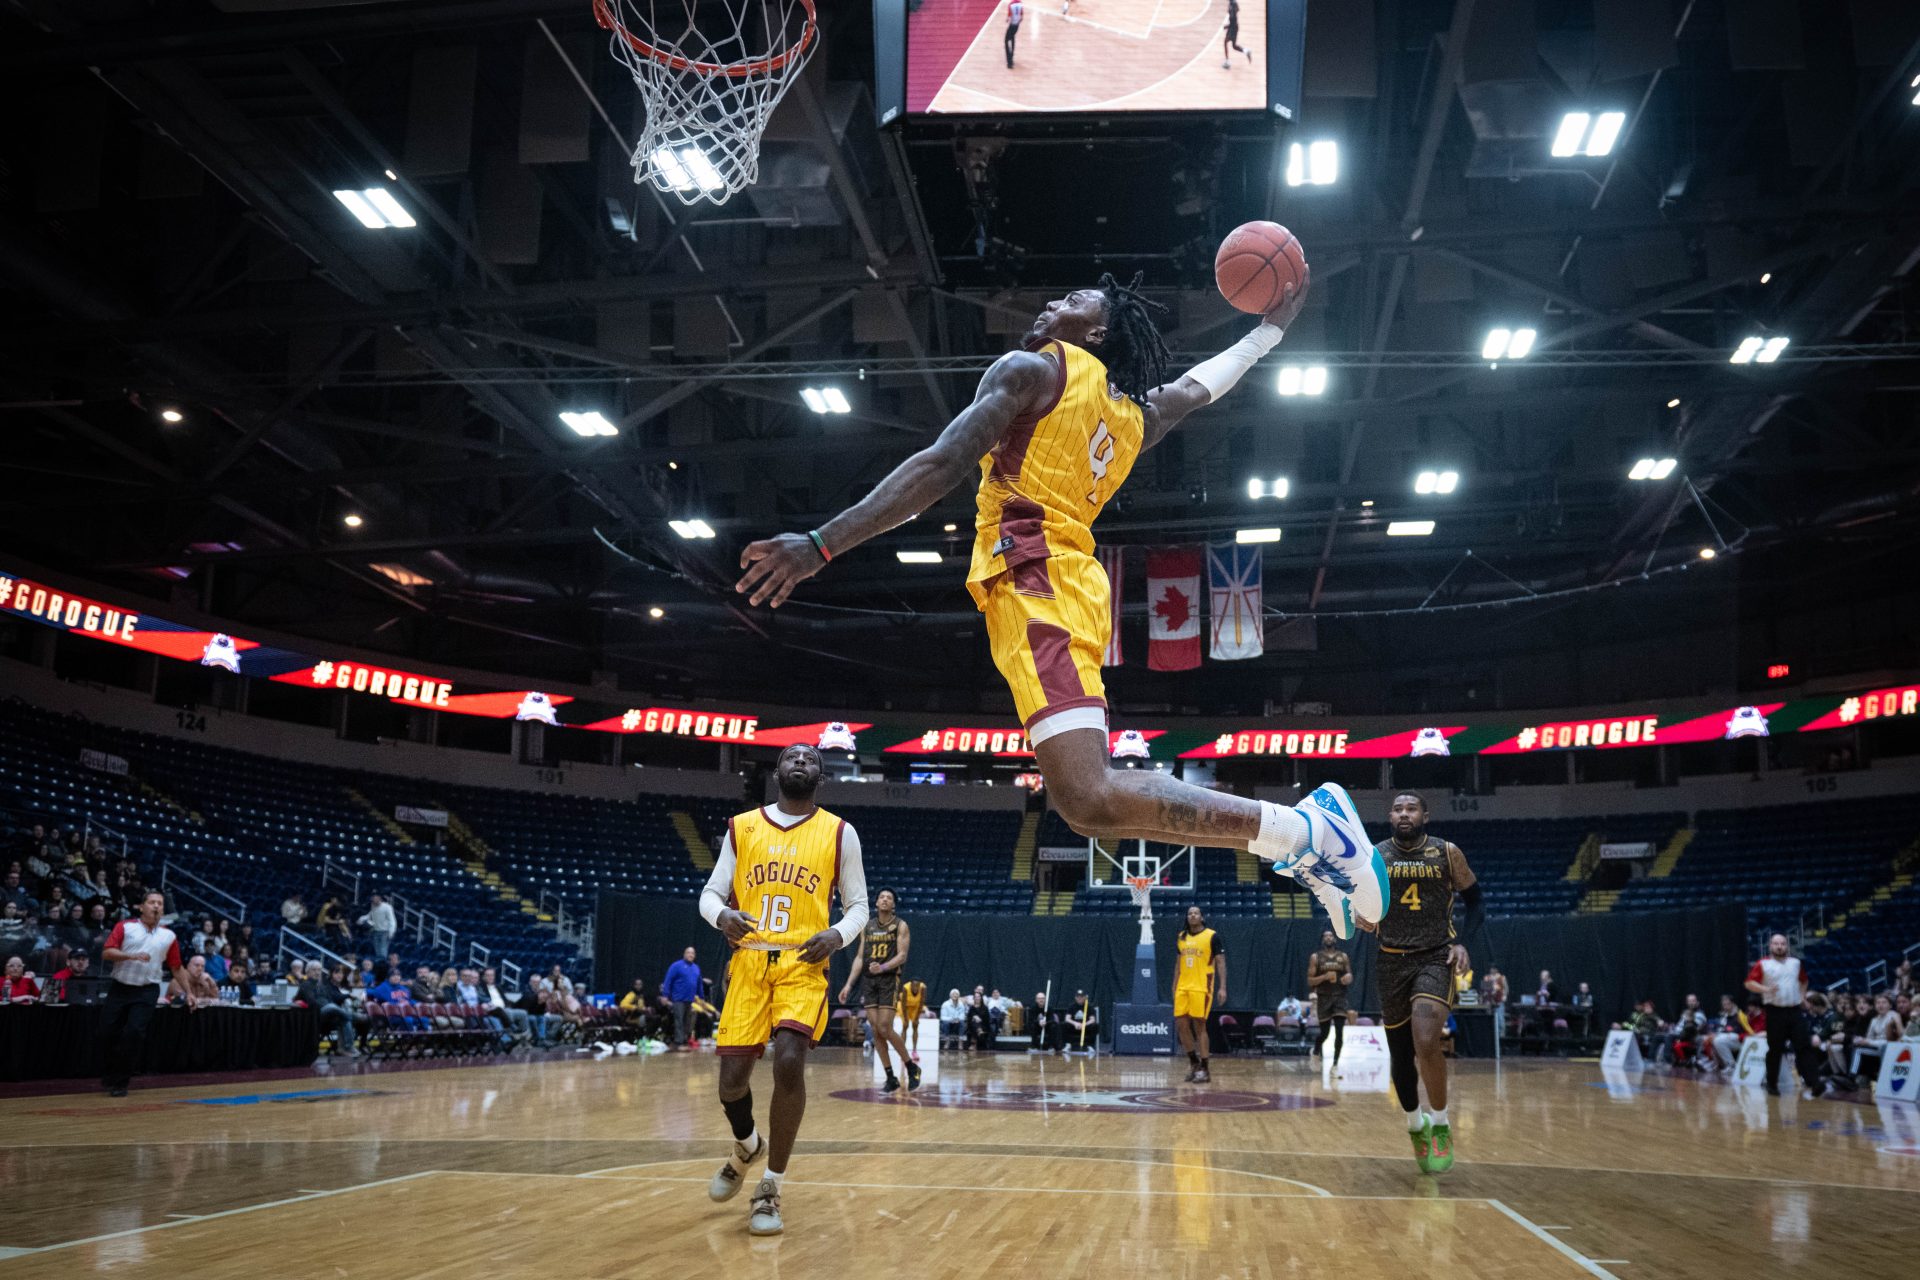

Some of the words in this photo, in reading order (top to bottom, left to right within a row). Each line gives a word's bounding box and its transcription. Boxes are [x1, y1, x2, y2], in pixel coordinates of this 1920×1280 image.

[0, 577, 138, 641] #GOROGUE
[312, 660, 452, 706] #GOROGUE
[176, 711, 206, 732] 124
[621, 709, 758, 740] #GOROGUE
[921, 730, 1027, 752] #GOROG
[1215, 733, 1348, 754] #GOROGUE
[1517, 719, 1657, 749] #GOROGUE
[1806, 776, 1837, 793] 105
[1450, 799, 1480, 812] 104
[1400, 882, 1422, 911] 4
[757, 894, 792, 933] 16
[871, 943, 888, 959] 10
[1120, 1022, 1168, 1035] eastlink
